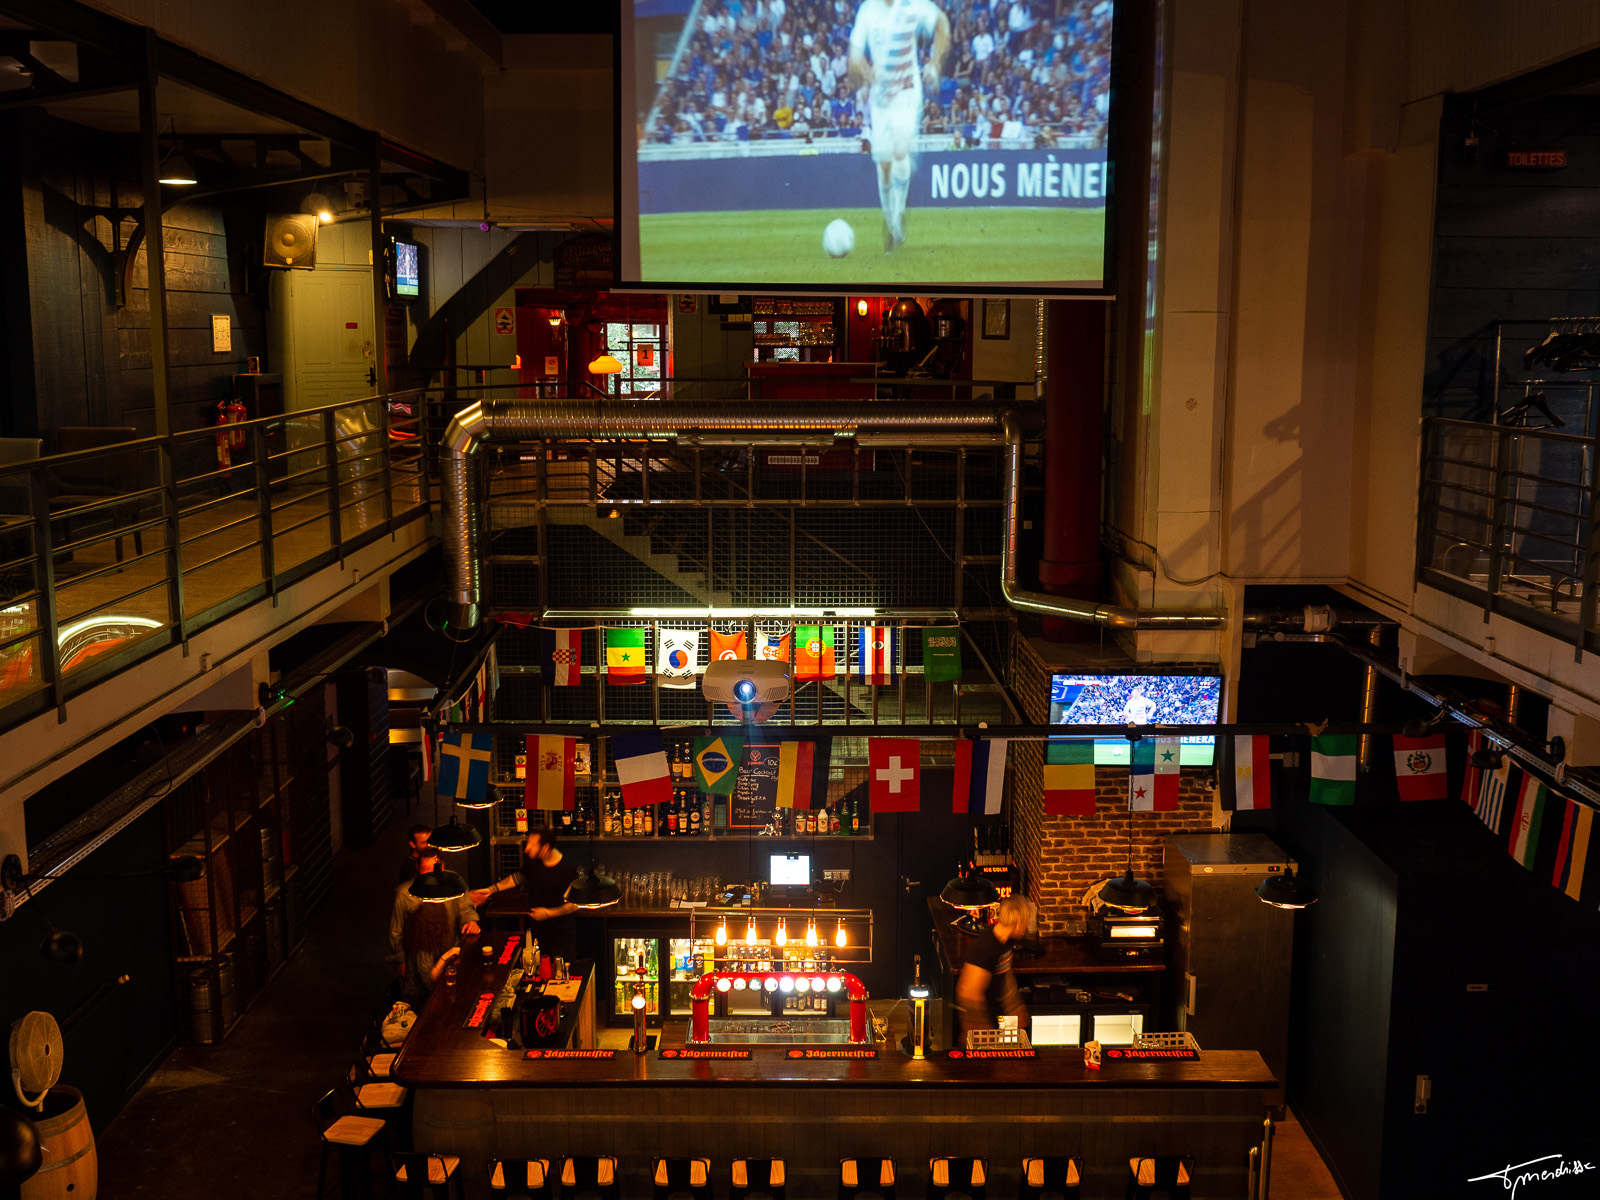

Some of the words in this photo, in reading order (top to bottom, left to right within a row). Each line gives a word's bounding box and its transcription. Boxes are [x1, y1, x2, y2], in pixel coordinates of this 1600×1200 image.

[1508, 152, 1564, 166] TOILETTES
[931, 162, 1006, 199] NOUS
[1017, 153, 1108, 199] MÈNE
[544, 1050, 614, 1059] Jägermeister
[679, 1049, 749, 1058] Jägermeister
[805, 1049, 876, 1058] Jägermeister
[966, 1049, 1036, 1059] Jägermeister
[1123, 1049, 1195, 1059] Jägermeister
